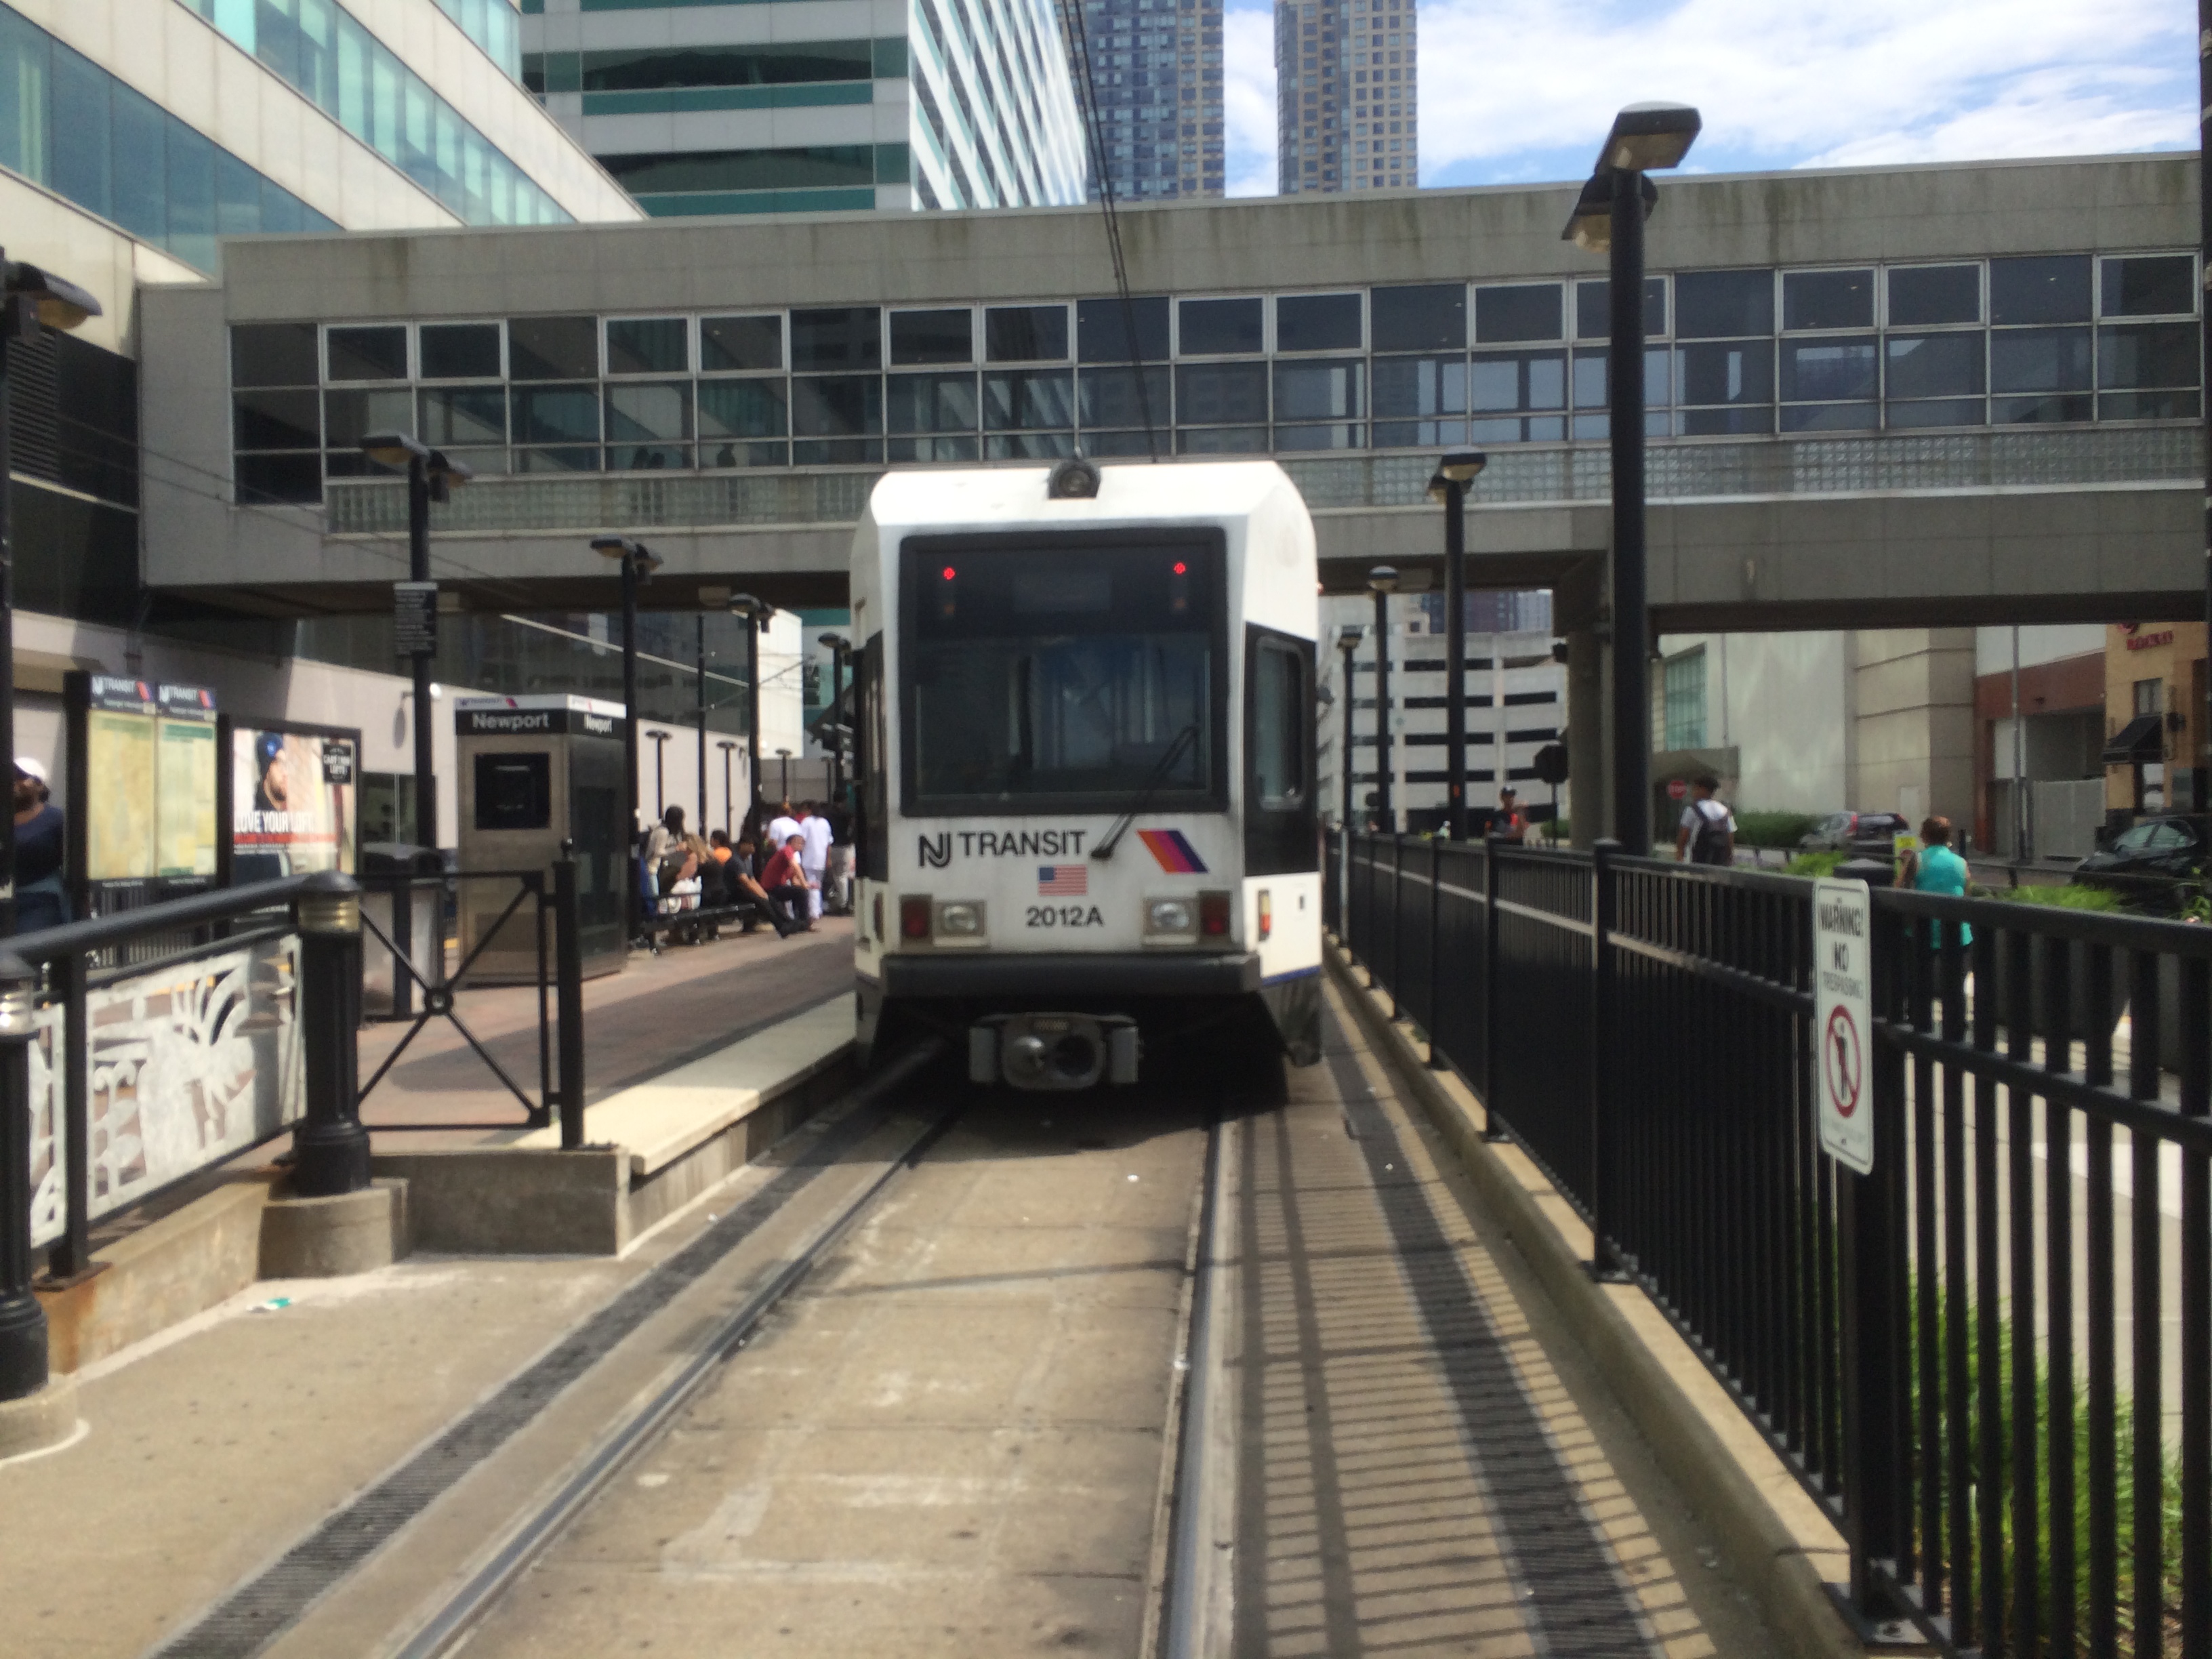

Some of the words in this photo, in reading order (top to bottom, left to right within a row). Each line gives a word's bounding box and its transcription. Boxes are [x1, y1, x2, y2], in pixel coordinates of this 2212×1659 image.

[91, 676, 104, 695] NJ
[104, 677, 136, 694] TRANSIT
[159, 684, 170, 704] NJ
[171, 685, 197, 701] TRANSIT
[472, 712, 550, 731] Newport
[584, 712, 613, 733] Newport
[234, 811, 261, 833] LOVE
[262, 811, 289, 833] YOUR
[918, 831, 951, 868] NJ
[957, 830, 1086, 859] TRANSIT
[1026, 905, 1104, 928] 2012A
[1820, 903, 1864, 937] WARNING!
[1833, 941, 1849, 972] NO
